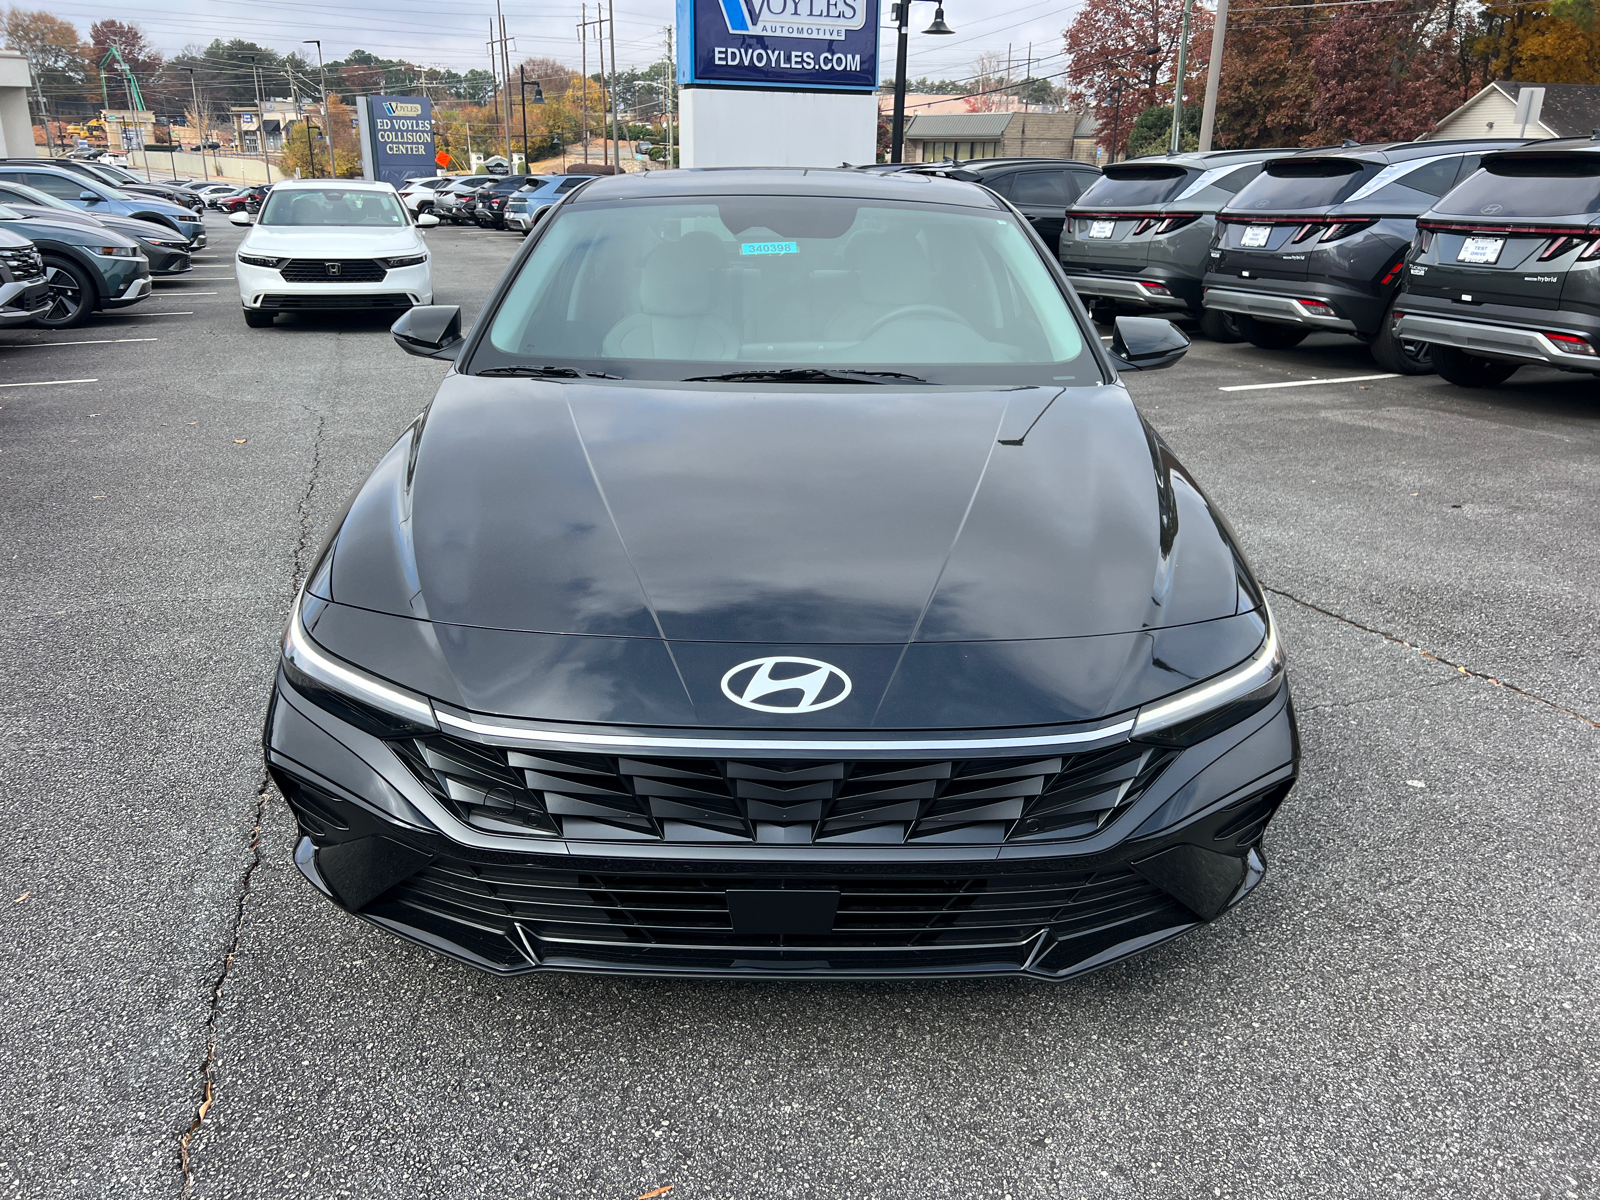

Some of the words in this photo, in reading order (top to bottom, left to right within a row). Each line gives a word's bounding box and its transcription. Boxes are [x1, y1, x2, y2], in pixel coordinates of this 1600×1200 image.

[761, 24, 843, 37] AUTOMOTIVE
[714, 47, 861, 71] EDVOYLES.COM
[388, 102, 419, 114] VOYLES
[377, 119, 391, 129] ED
[393, 119, 431, 131] VOYLES
[378, 131, 431, 143] COLLISION
[386, 144, 426, 155] CENTER
[748, 244, 792, 253] 340398
